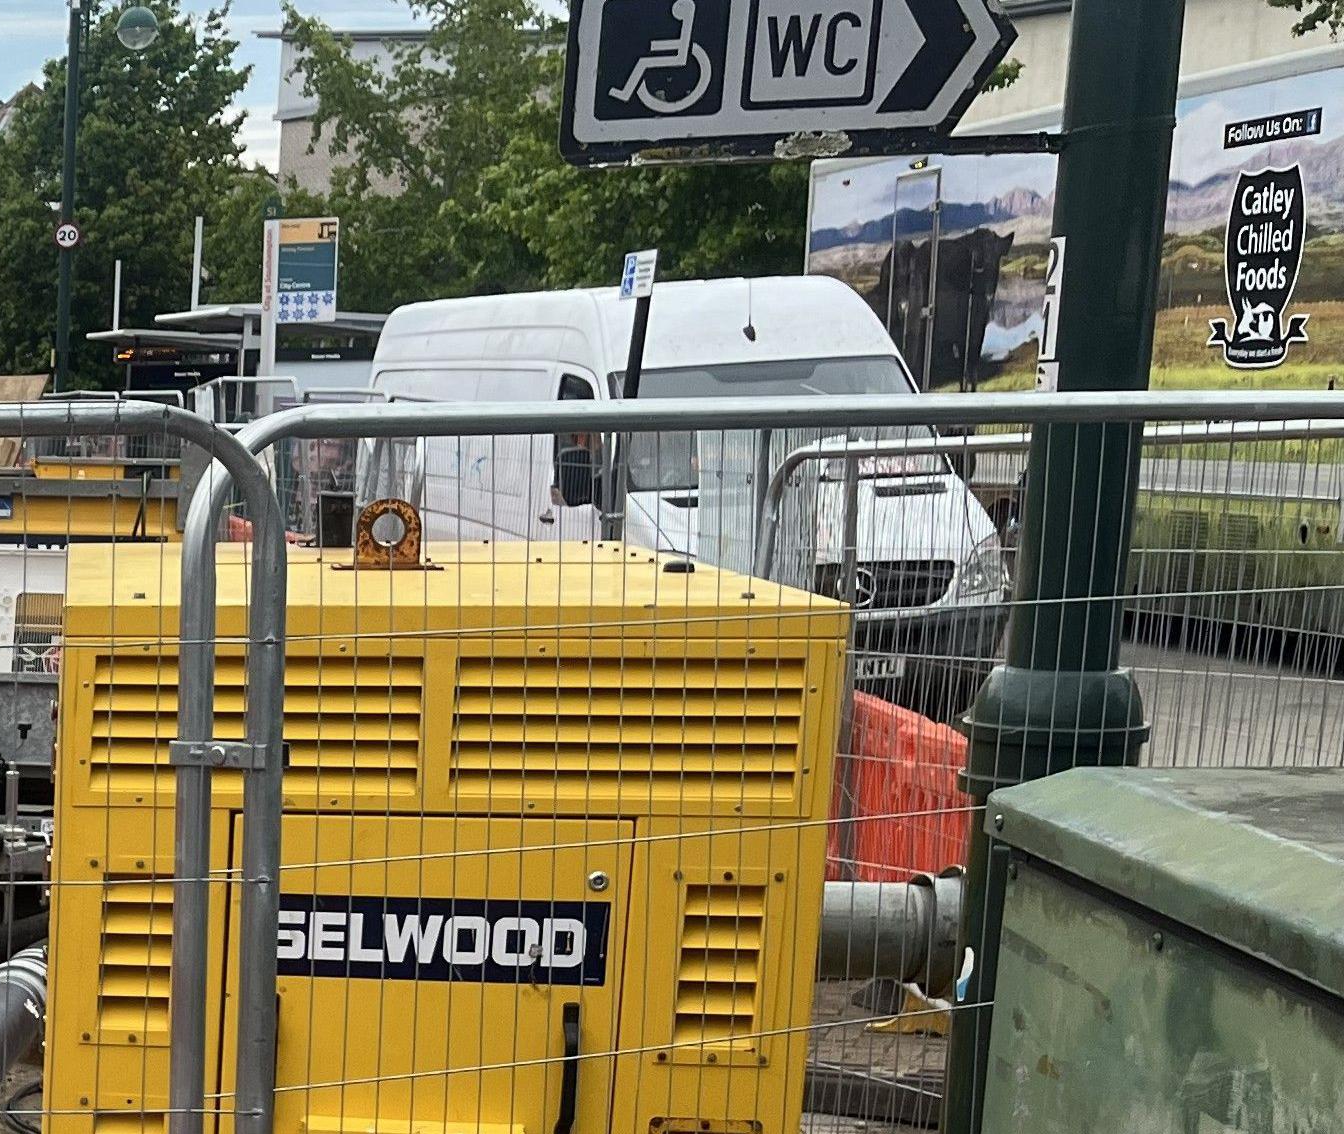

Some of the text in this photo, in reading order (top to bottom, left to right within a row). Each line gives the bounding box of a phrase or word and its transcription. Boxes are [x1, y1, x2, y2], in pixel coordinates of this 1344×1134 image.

[767, 11, 862, 78] WC
[1228, 123, 1264, 143] Follow
[1266, 119, 1281, 137] Us
[1282, 117, 1303, 133] On:
[1241, 181, 1295, 220] Catley
[59, 230, 76, 241] 20
[1237, 219, 1294, 255] Chilled
[1236, 258, 1287, 292] Foods
[276, 910, 587, 968] SELWOOD
